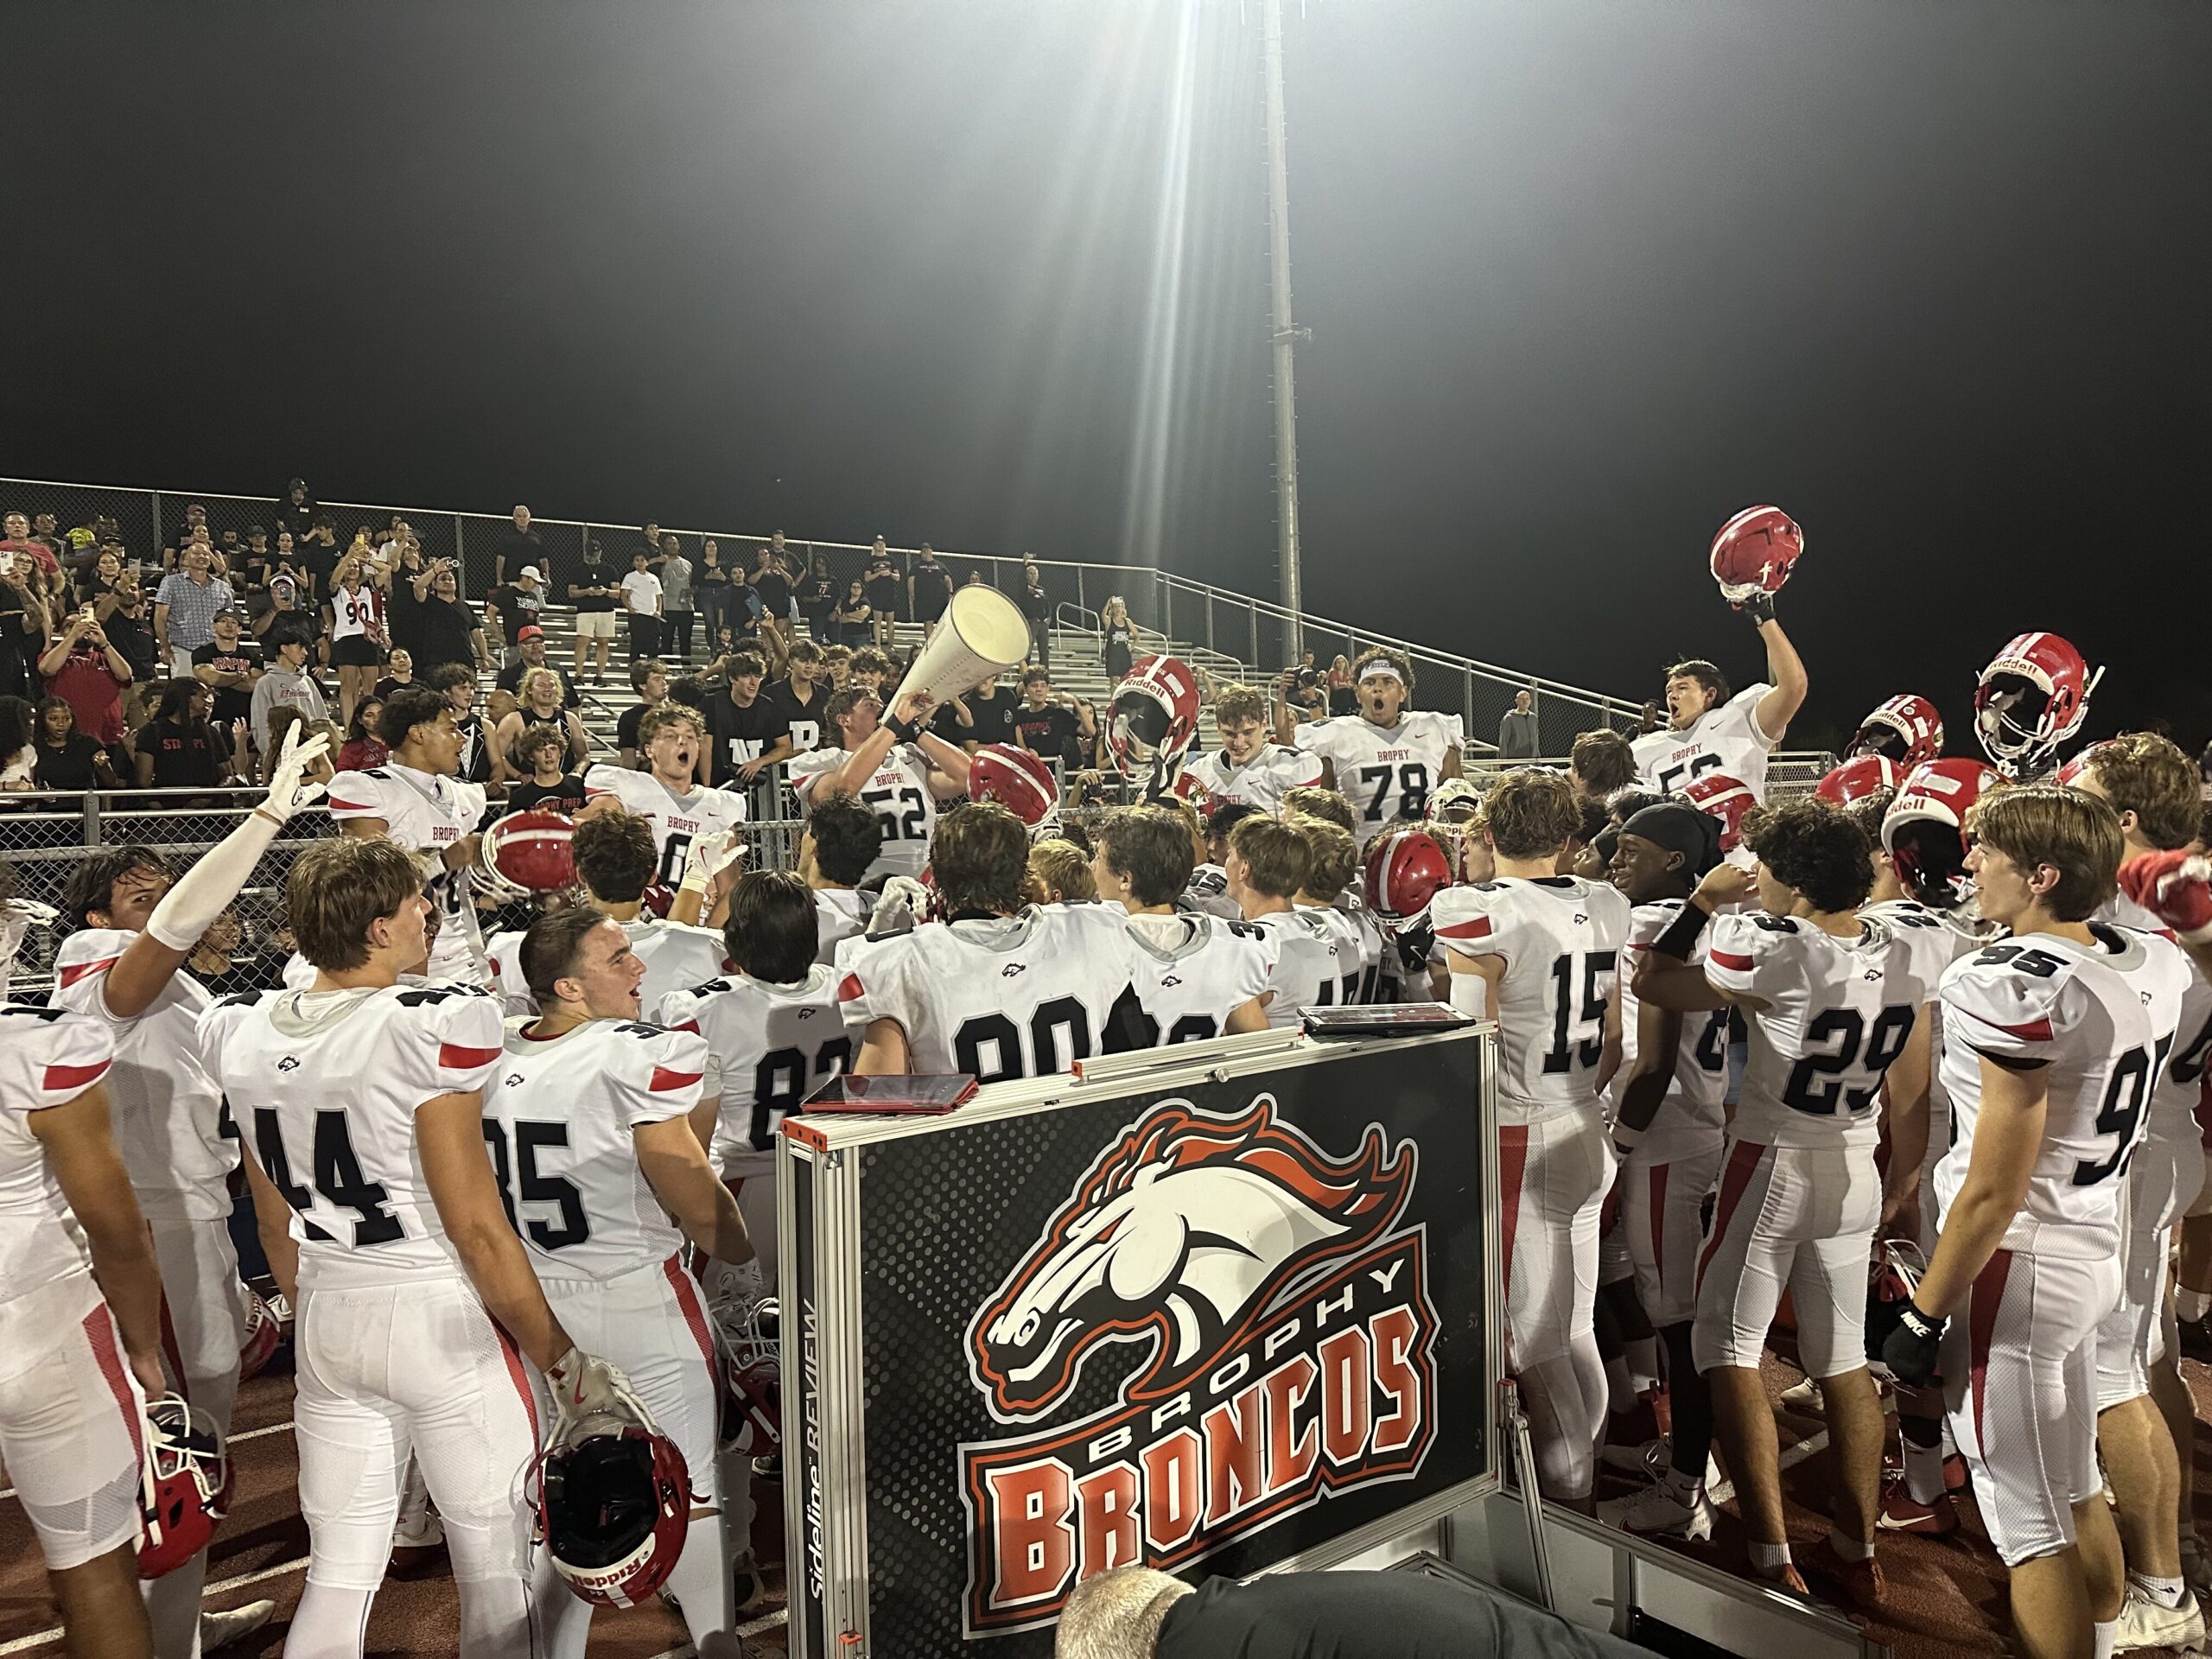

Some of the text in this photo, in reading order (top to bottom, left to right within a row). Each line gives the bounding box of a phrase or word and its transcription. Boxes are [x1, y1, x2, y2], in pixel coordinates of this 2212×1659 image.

[346, 602, 370, 625] 90
[1125, 678, 1165, 699] Riddell
[789, 720, 819, 752] R
[1377, 749, 1409, 762] BROPHY
[1672, 743, 1702, 763] BROPHY
[1361, 763, 1428, 822] 78
[667, 816, 700, 833] BROPHY
[861, 787, 927, 842] 52
[1972, 945, 2071, 978] 95
[1542, 950, 1618, 1075] 15
[1781, 1003, 1916, 1117] 29
[252, 1105, 408, 1248] 44
[1900, 1311, 1931, 1338] NIKE
[804, 1298, 821, 1453] REVIEW
[1088, 1257, 1406, 1464] BROPHY
[985, 1303, 1420, 1610] BRONCOS
[570, 1557, 642, 1587] Riddell
